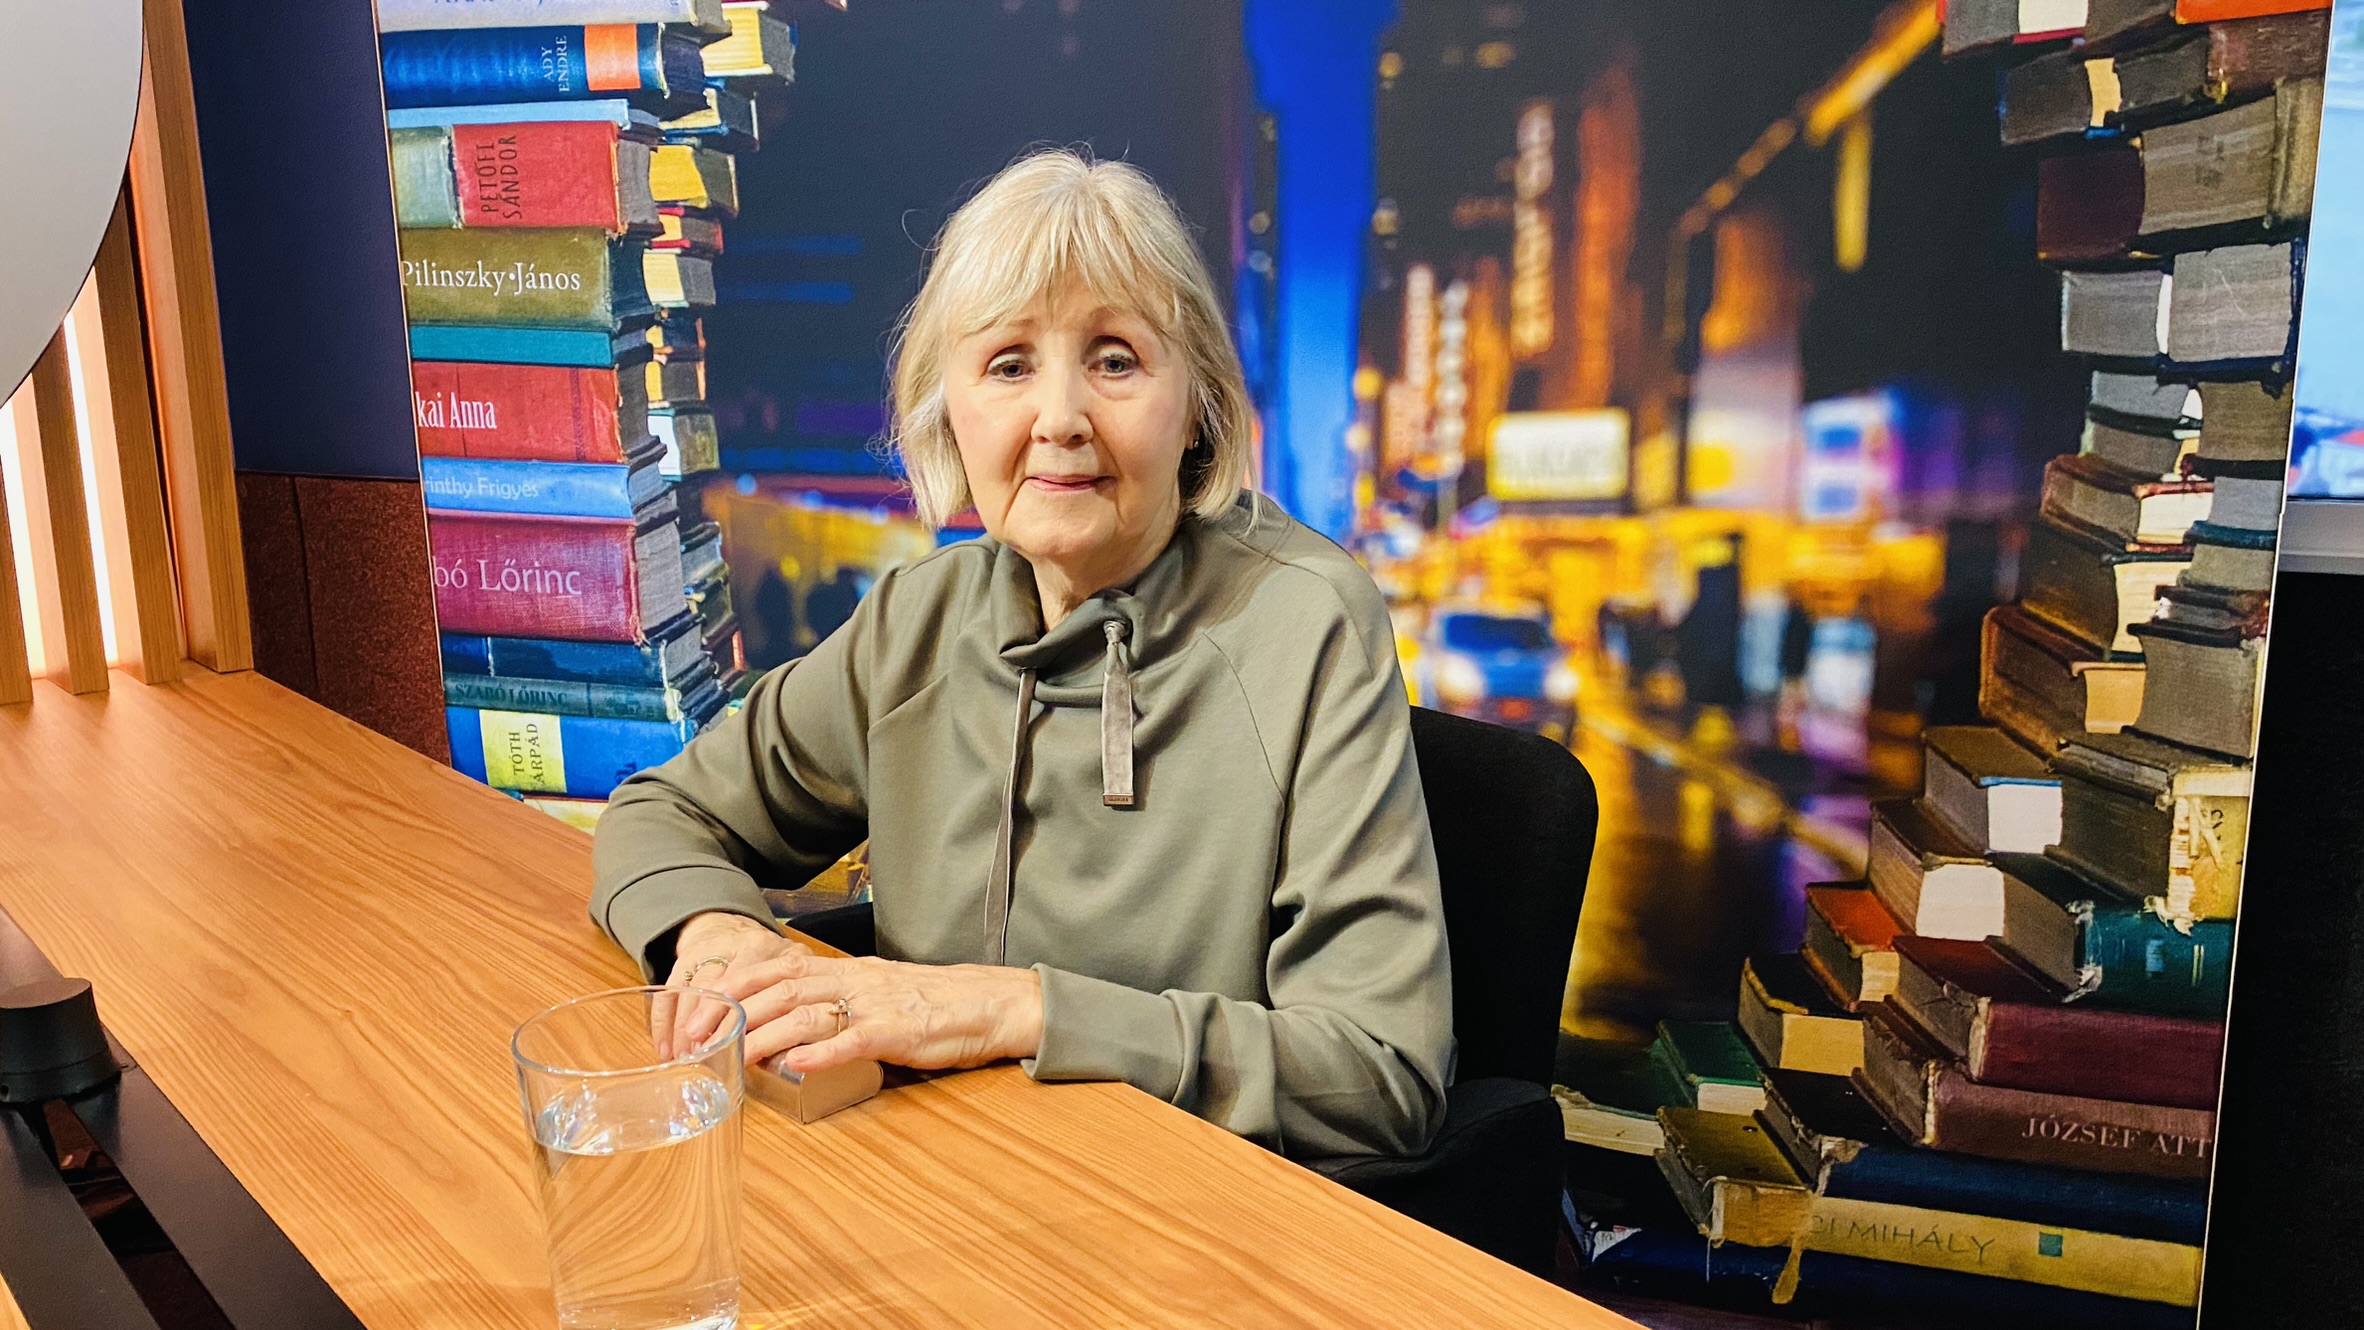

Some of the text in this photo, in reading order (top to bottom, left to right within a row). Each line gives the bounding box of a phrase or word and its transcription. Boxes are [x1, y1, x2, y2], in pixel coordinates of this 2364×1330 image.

[541, 46, 555, 82] ADY
[556, 35, 570, 93] ENDRE
[498, 135, 522, 219] SÁNDOR
[415, 391, 497, 429] kai Anna
[477, 477, 539, 500] Frigyes
[476, 558, 582, 595] Lőrinc
[455, 681, 507, 701] SZABÓ
[508, 732, 525, 776] TÓTH
[525, 723, 546, 785] ÁRPÁD
[2021, 1114, 2141, 1148] JÓZSEF
[1849, 1223, 1996, 1266] MIHÁLY
